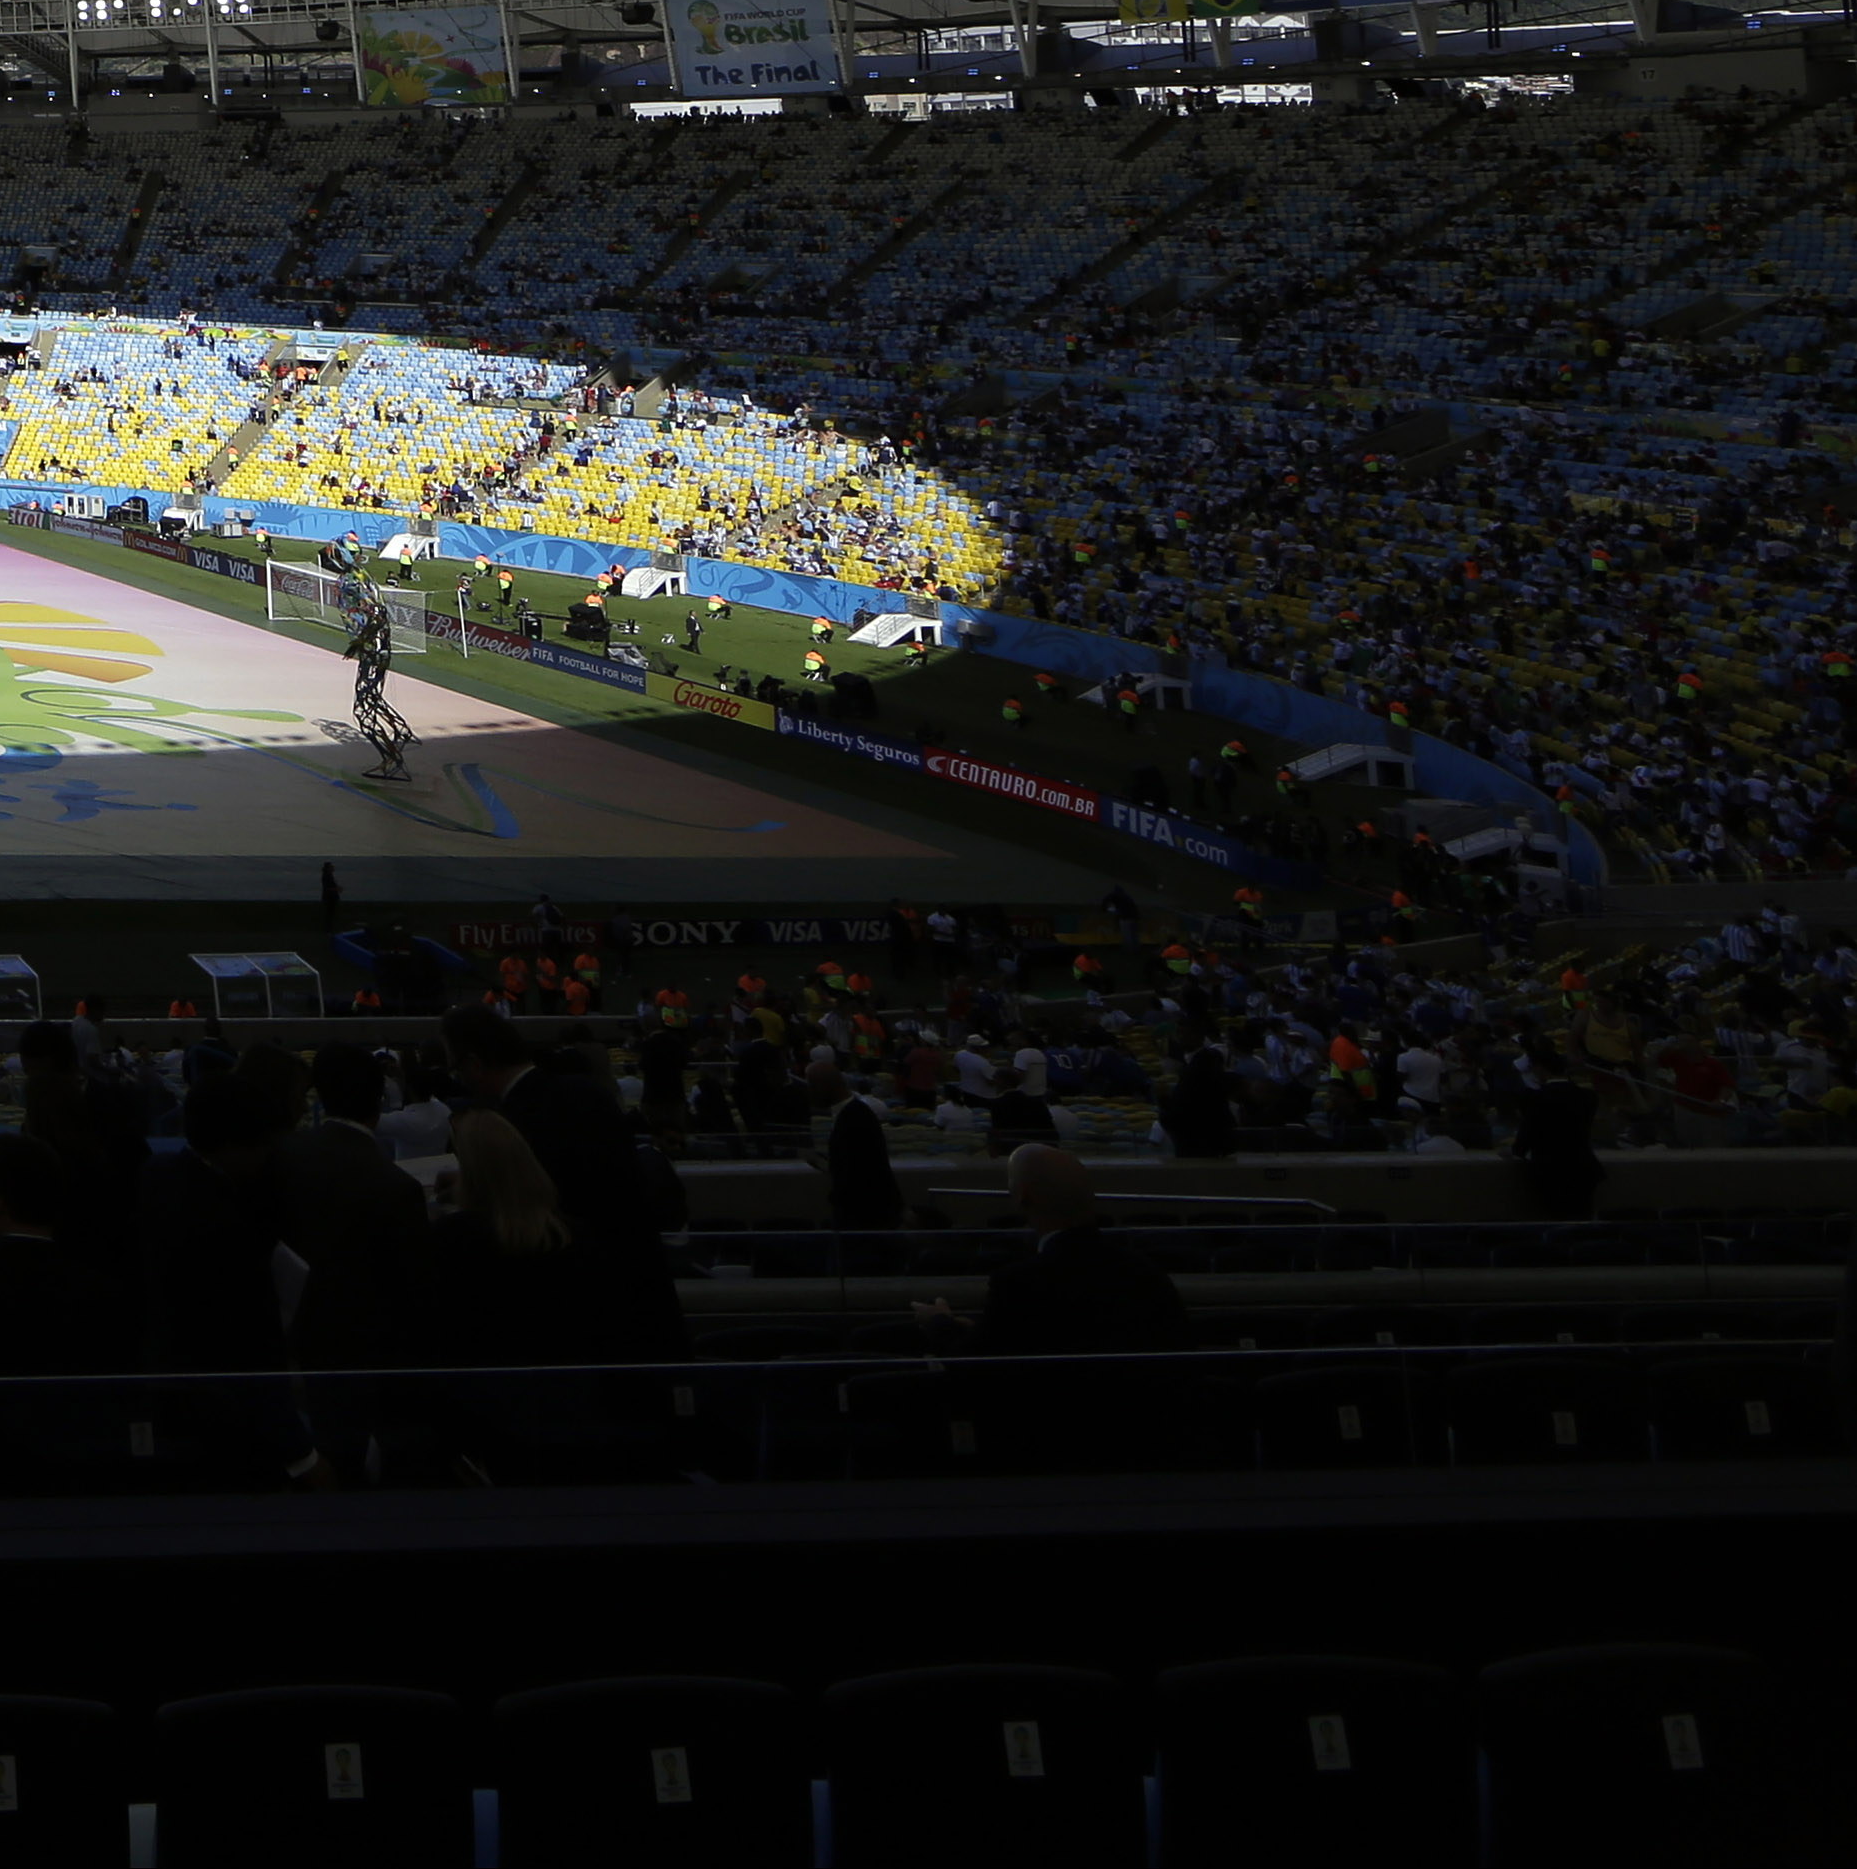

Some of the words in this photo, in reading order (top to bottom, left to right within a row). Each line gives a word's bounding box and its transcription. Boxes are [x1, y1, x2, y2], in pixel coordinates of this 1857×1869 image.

[724, 12, 746, 21] FIFA
[748, 10, 784, 20] WORLD
[786, 8, 806, 17] CUP
[724, 19, 810, 45] Brasil
[695, 64, 744, 85] The
[751, 59, 820, 84] Final
[1642, 69, 1655, 80] 17
[193, 550, 221, 573] VISA
[228, 559, 256, 583] VISA
[427, 612, 531, 660] Budweiser
[532, 647, 554, 663] FIFA
[559, 655, 601, 675] FOOTBALL
[602, 667, 619, 681] FOR
[621, 672, 644, 687] HOPE
[674, 681, 742, 718] Garoto
[798, 719, 854, 751] Liberty
[857, 734, 920, 766] Seguros
[458, 924, 495, 948] Fly
[630, 921, 742, 946] SONY
[767, 920, 823, 943] VISA
[842, 920, 893, 943] VISA
[1050, 1054, 1073, 1069] 10
